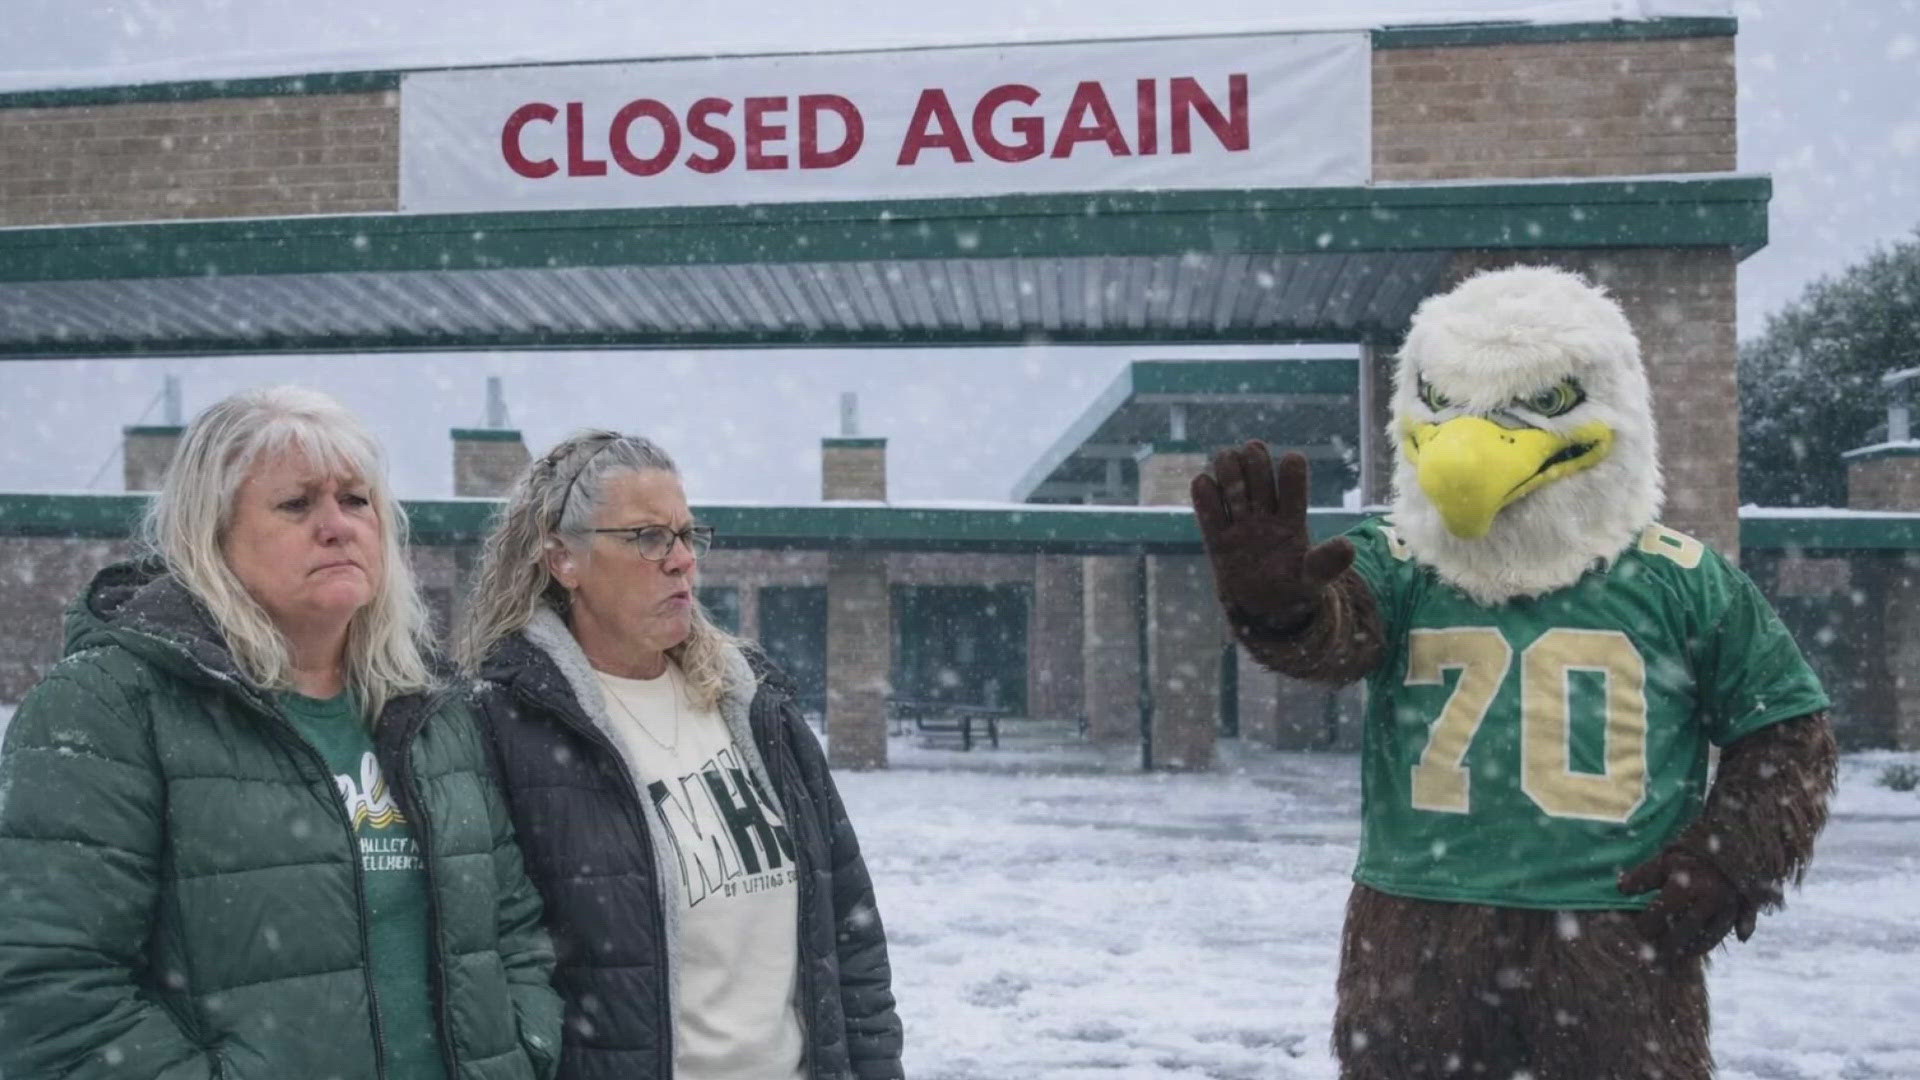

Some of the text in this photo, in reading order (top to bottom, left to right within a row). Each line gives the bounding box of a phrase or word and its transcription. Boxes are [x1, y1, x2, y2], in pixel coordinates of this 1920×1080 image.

[501, 73, 1250, 179] CLOSED AGAIN
[1403, 626, 1647, 823] 70
